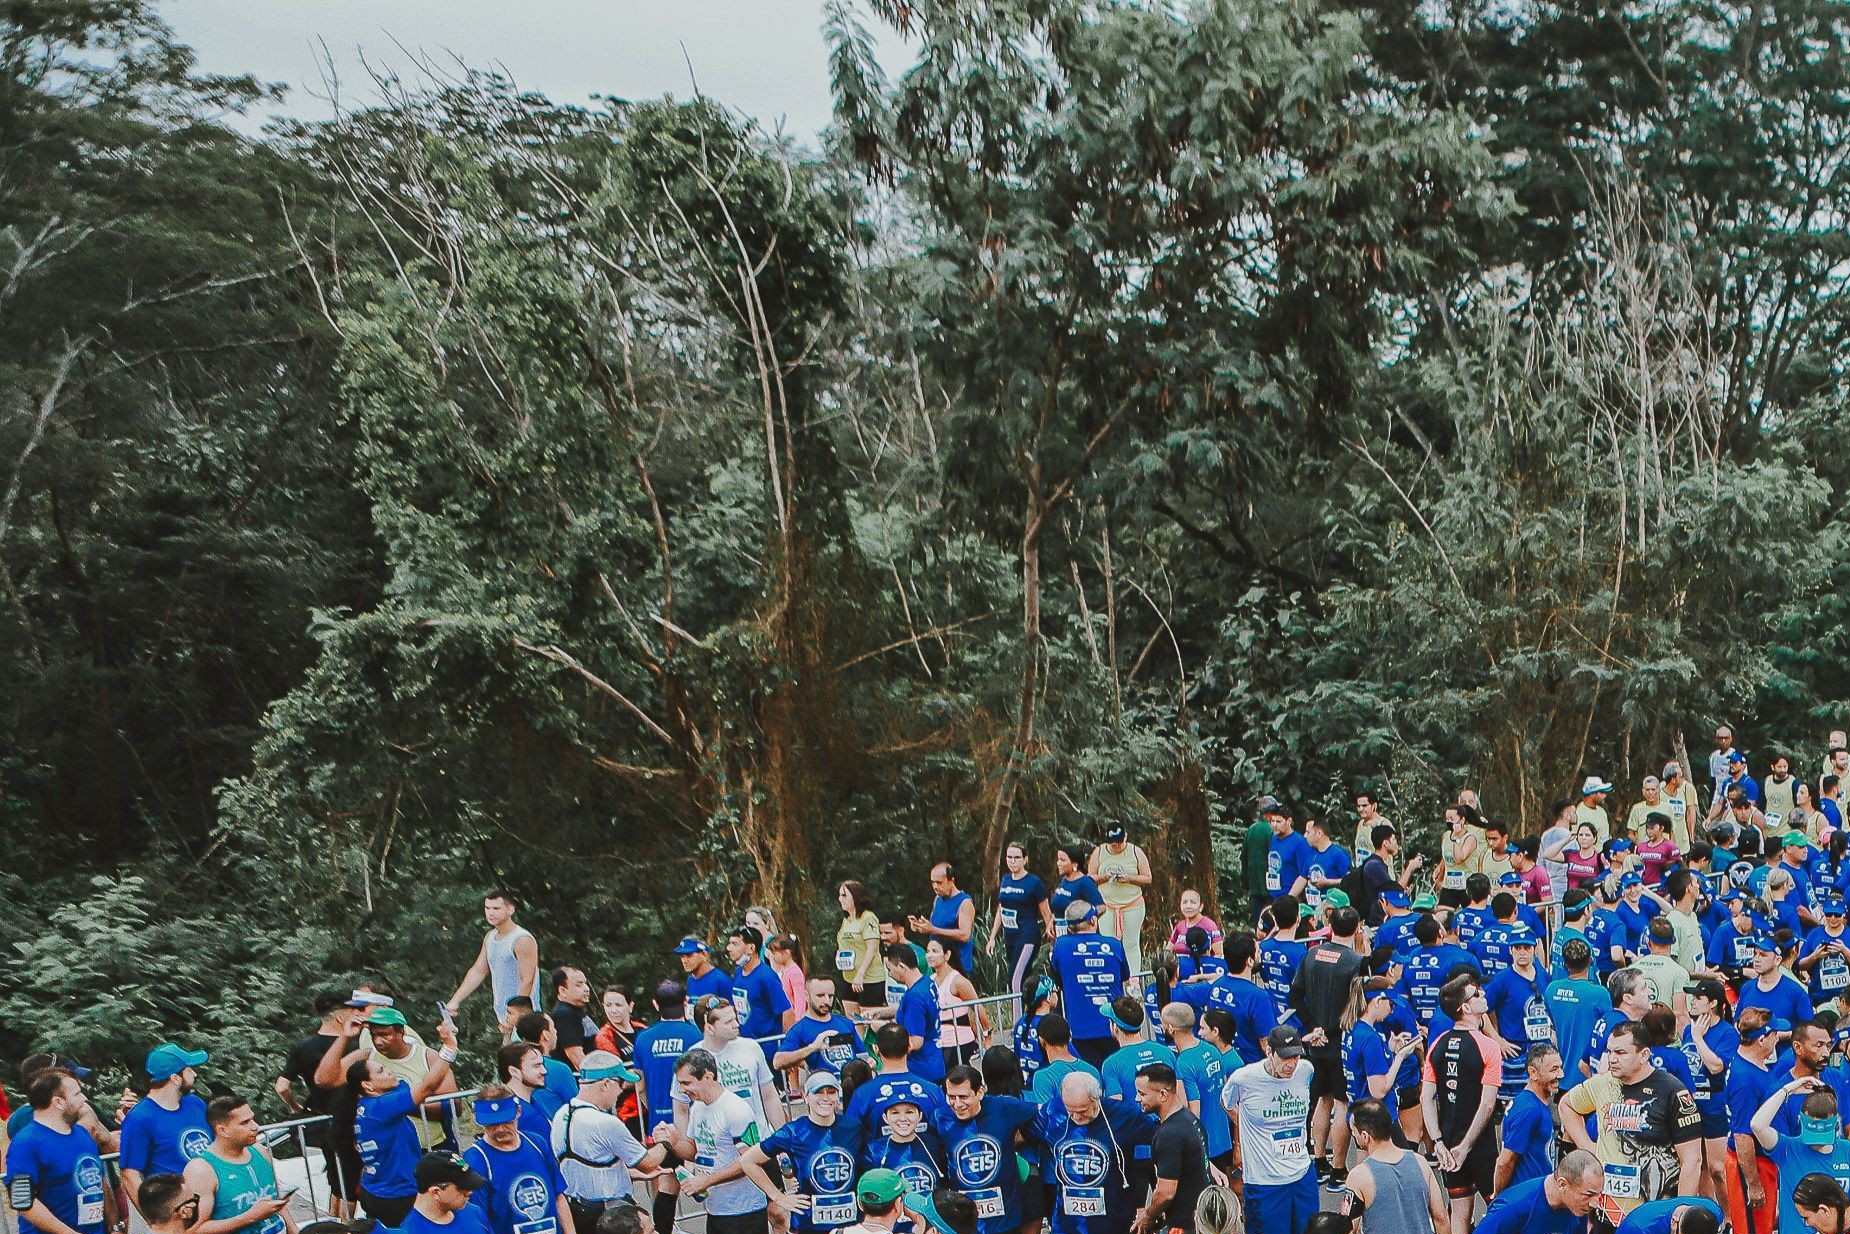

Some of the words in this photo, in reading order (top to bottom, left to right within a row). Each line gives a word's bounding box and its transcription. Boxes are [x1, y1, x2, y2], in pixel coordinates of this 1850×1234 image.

[1825, 977, 1848, 988] 1100
[652, 1038, 683, 1054] ATLETA
[1279, 1100, 1305, 1110] Equipe
[1263, 1107, 1307, 1119] Unimed
[1279, 1143, 1302, 1155] 748
[969, 1156, 996, 1173] EIS
[1073, 1158, 1102, 1176] EIS
[825, 1168, 850, 1182] EIS
[1607, 1180, 1631, 1195] 145
[525, 1188, 547, 1205] EIS
[816, 1207, 853, 1221] 1140
[1071, 1200, 1098, 1214] 284
